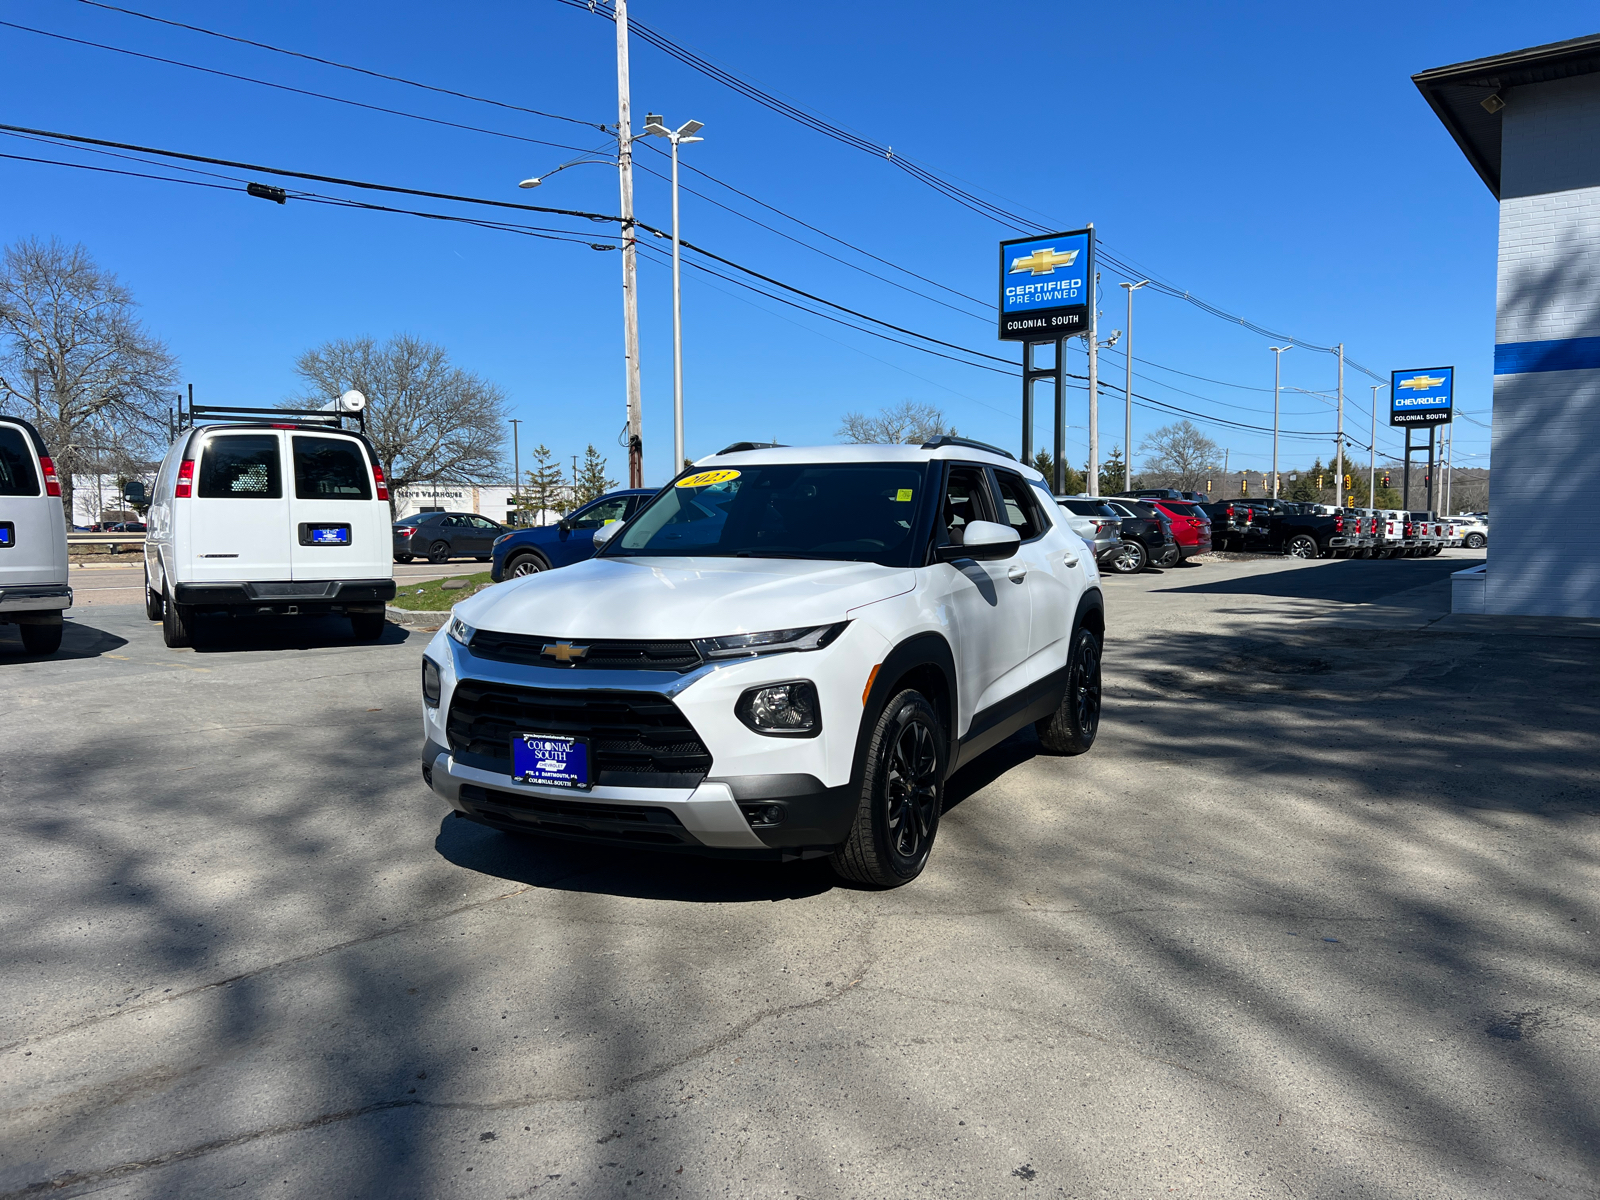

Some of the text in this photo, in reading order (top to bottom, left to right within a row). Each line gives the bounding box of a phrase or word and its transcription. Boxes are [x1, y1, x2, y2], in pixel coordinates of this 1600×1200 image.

[1006, 278, 1082, 296] CERTIFIED
[1009, 288, 1078, 305] PRE-OWNED
[1007, 314, 1079, 330] COLONIAL SOUTH
[1395, 396, 1448, 406] CHEVROLET
[1394, 414, 1424, 422] COLONIAL
[683, 471, 731, 486] 2023
[527, 740, 574, 753] COLONIAL
[534, 750, 567, 760] SOUTH
